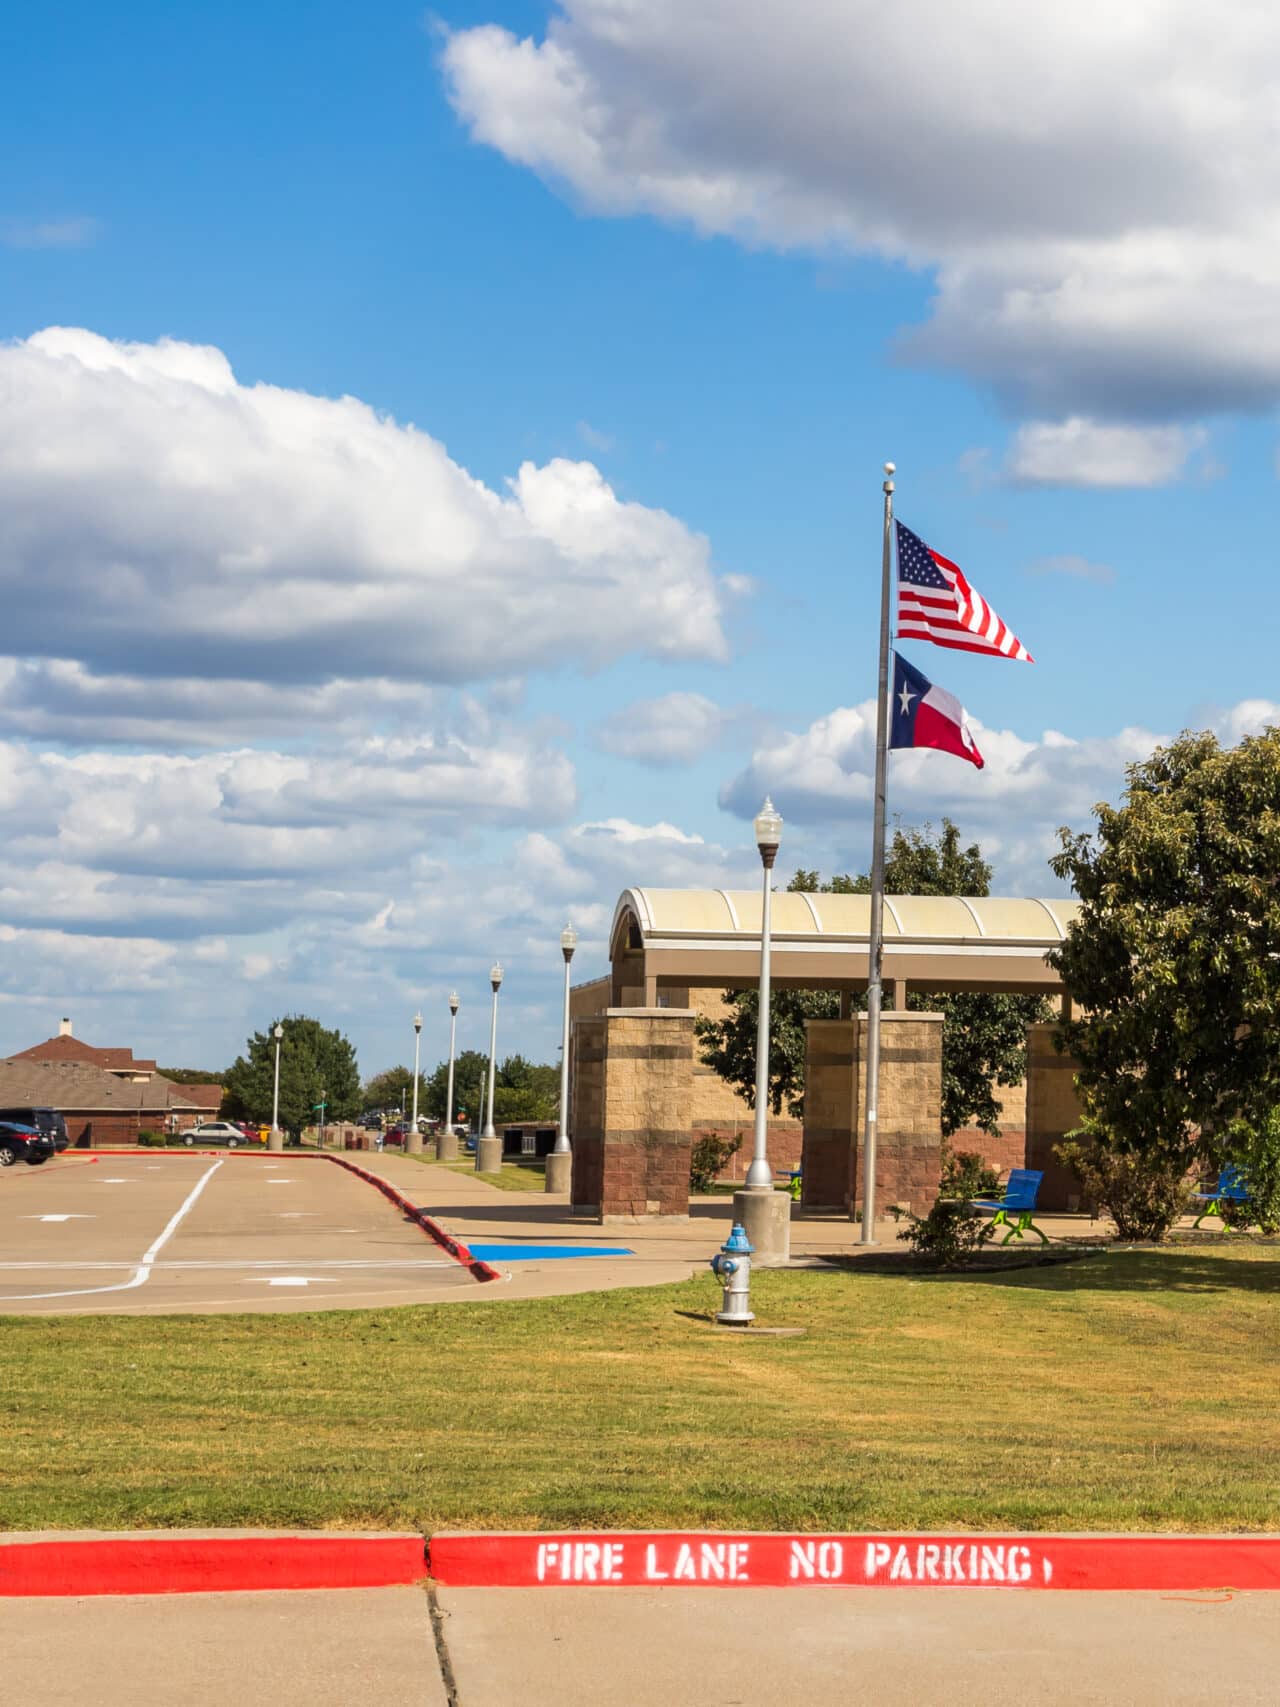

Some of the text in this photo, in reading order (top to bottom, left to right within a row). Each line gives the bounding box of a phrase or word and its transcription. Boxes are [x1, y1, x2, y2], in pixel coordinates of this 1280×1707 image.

[536, 1541, 1032, 1582] FIRE LANE NO PARKING
